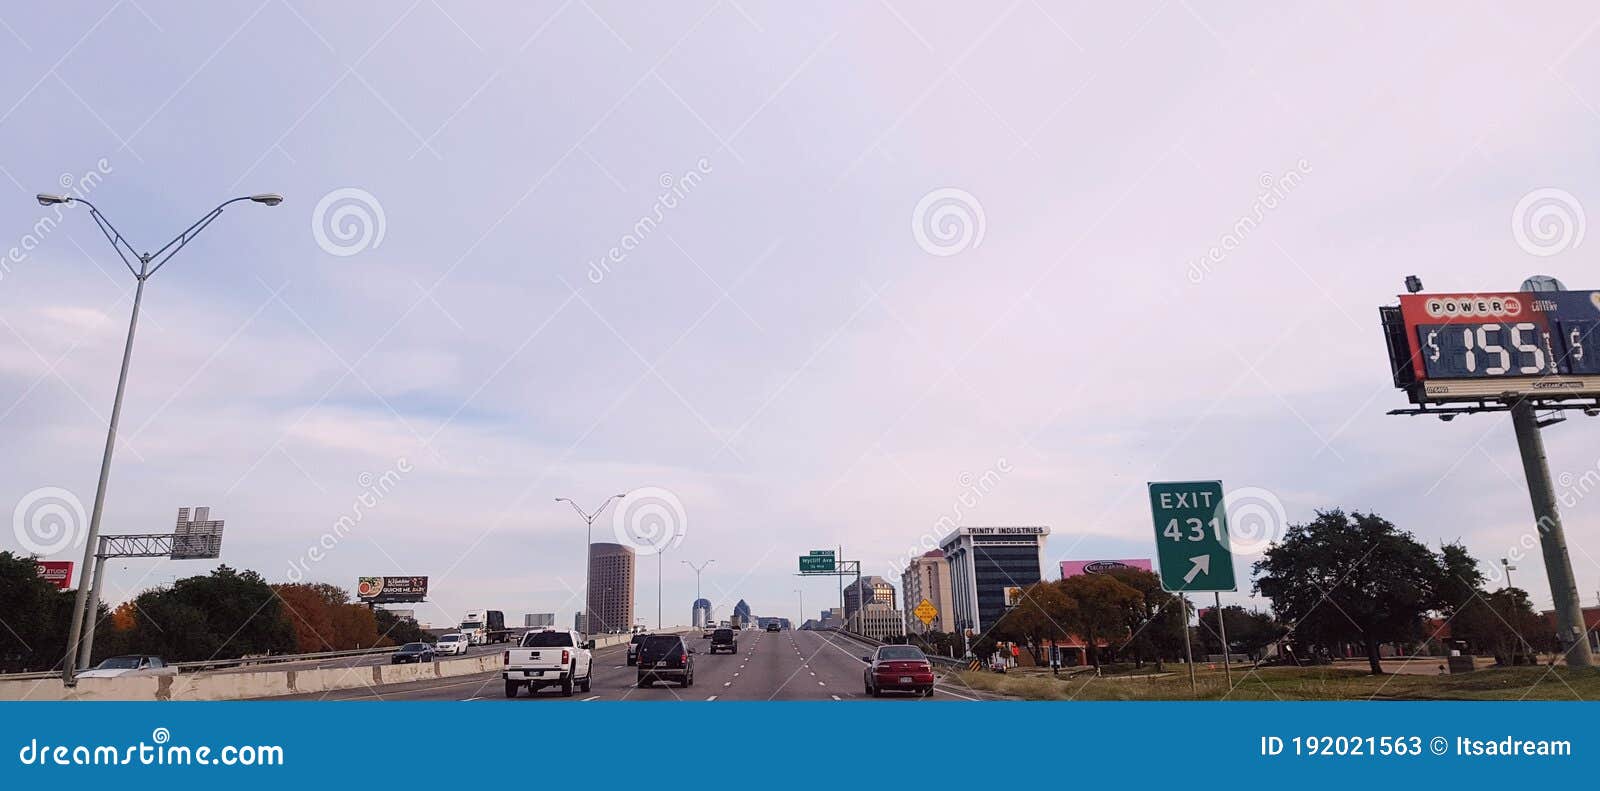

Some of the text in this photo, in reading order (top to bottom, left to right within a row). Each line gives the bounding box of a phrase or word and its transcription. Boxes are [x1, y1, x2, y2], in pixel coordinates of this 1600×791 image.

[1463, 322, 1546, 375] 155
[1159, 491, 1213, 509] EXIT
[1163, 517, 1222, 542] 431
